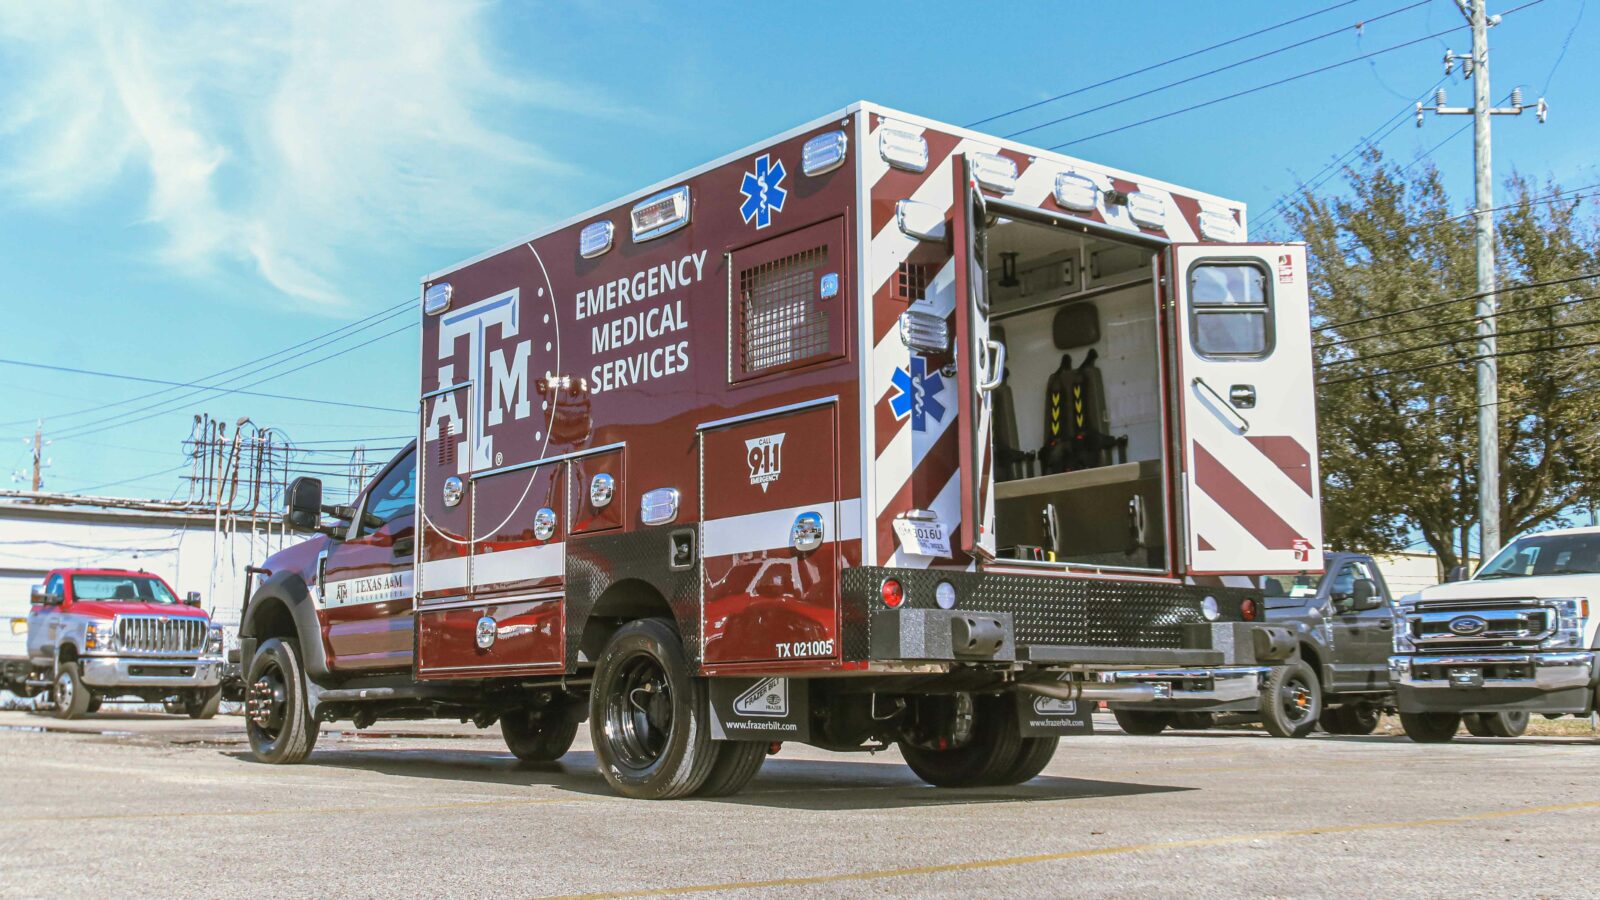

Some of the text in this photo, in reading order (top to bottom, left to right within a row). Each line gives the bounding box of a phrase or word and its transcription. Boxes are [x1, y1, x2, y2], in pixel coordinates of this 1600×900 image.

[576, 250, 707, 320] EMERGENCY
[591, 300, 688, 354] MEDICAL
[591, 341, 689, 395] SERVICES
[355, 574, 403, 593] TEXAS A&M
[776, 640, 833, 658] TX 021005
[726, 720, 797, 731] www.frazerbilt.com
